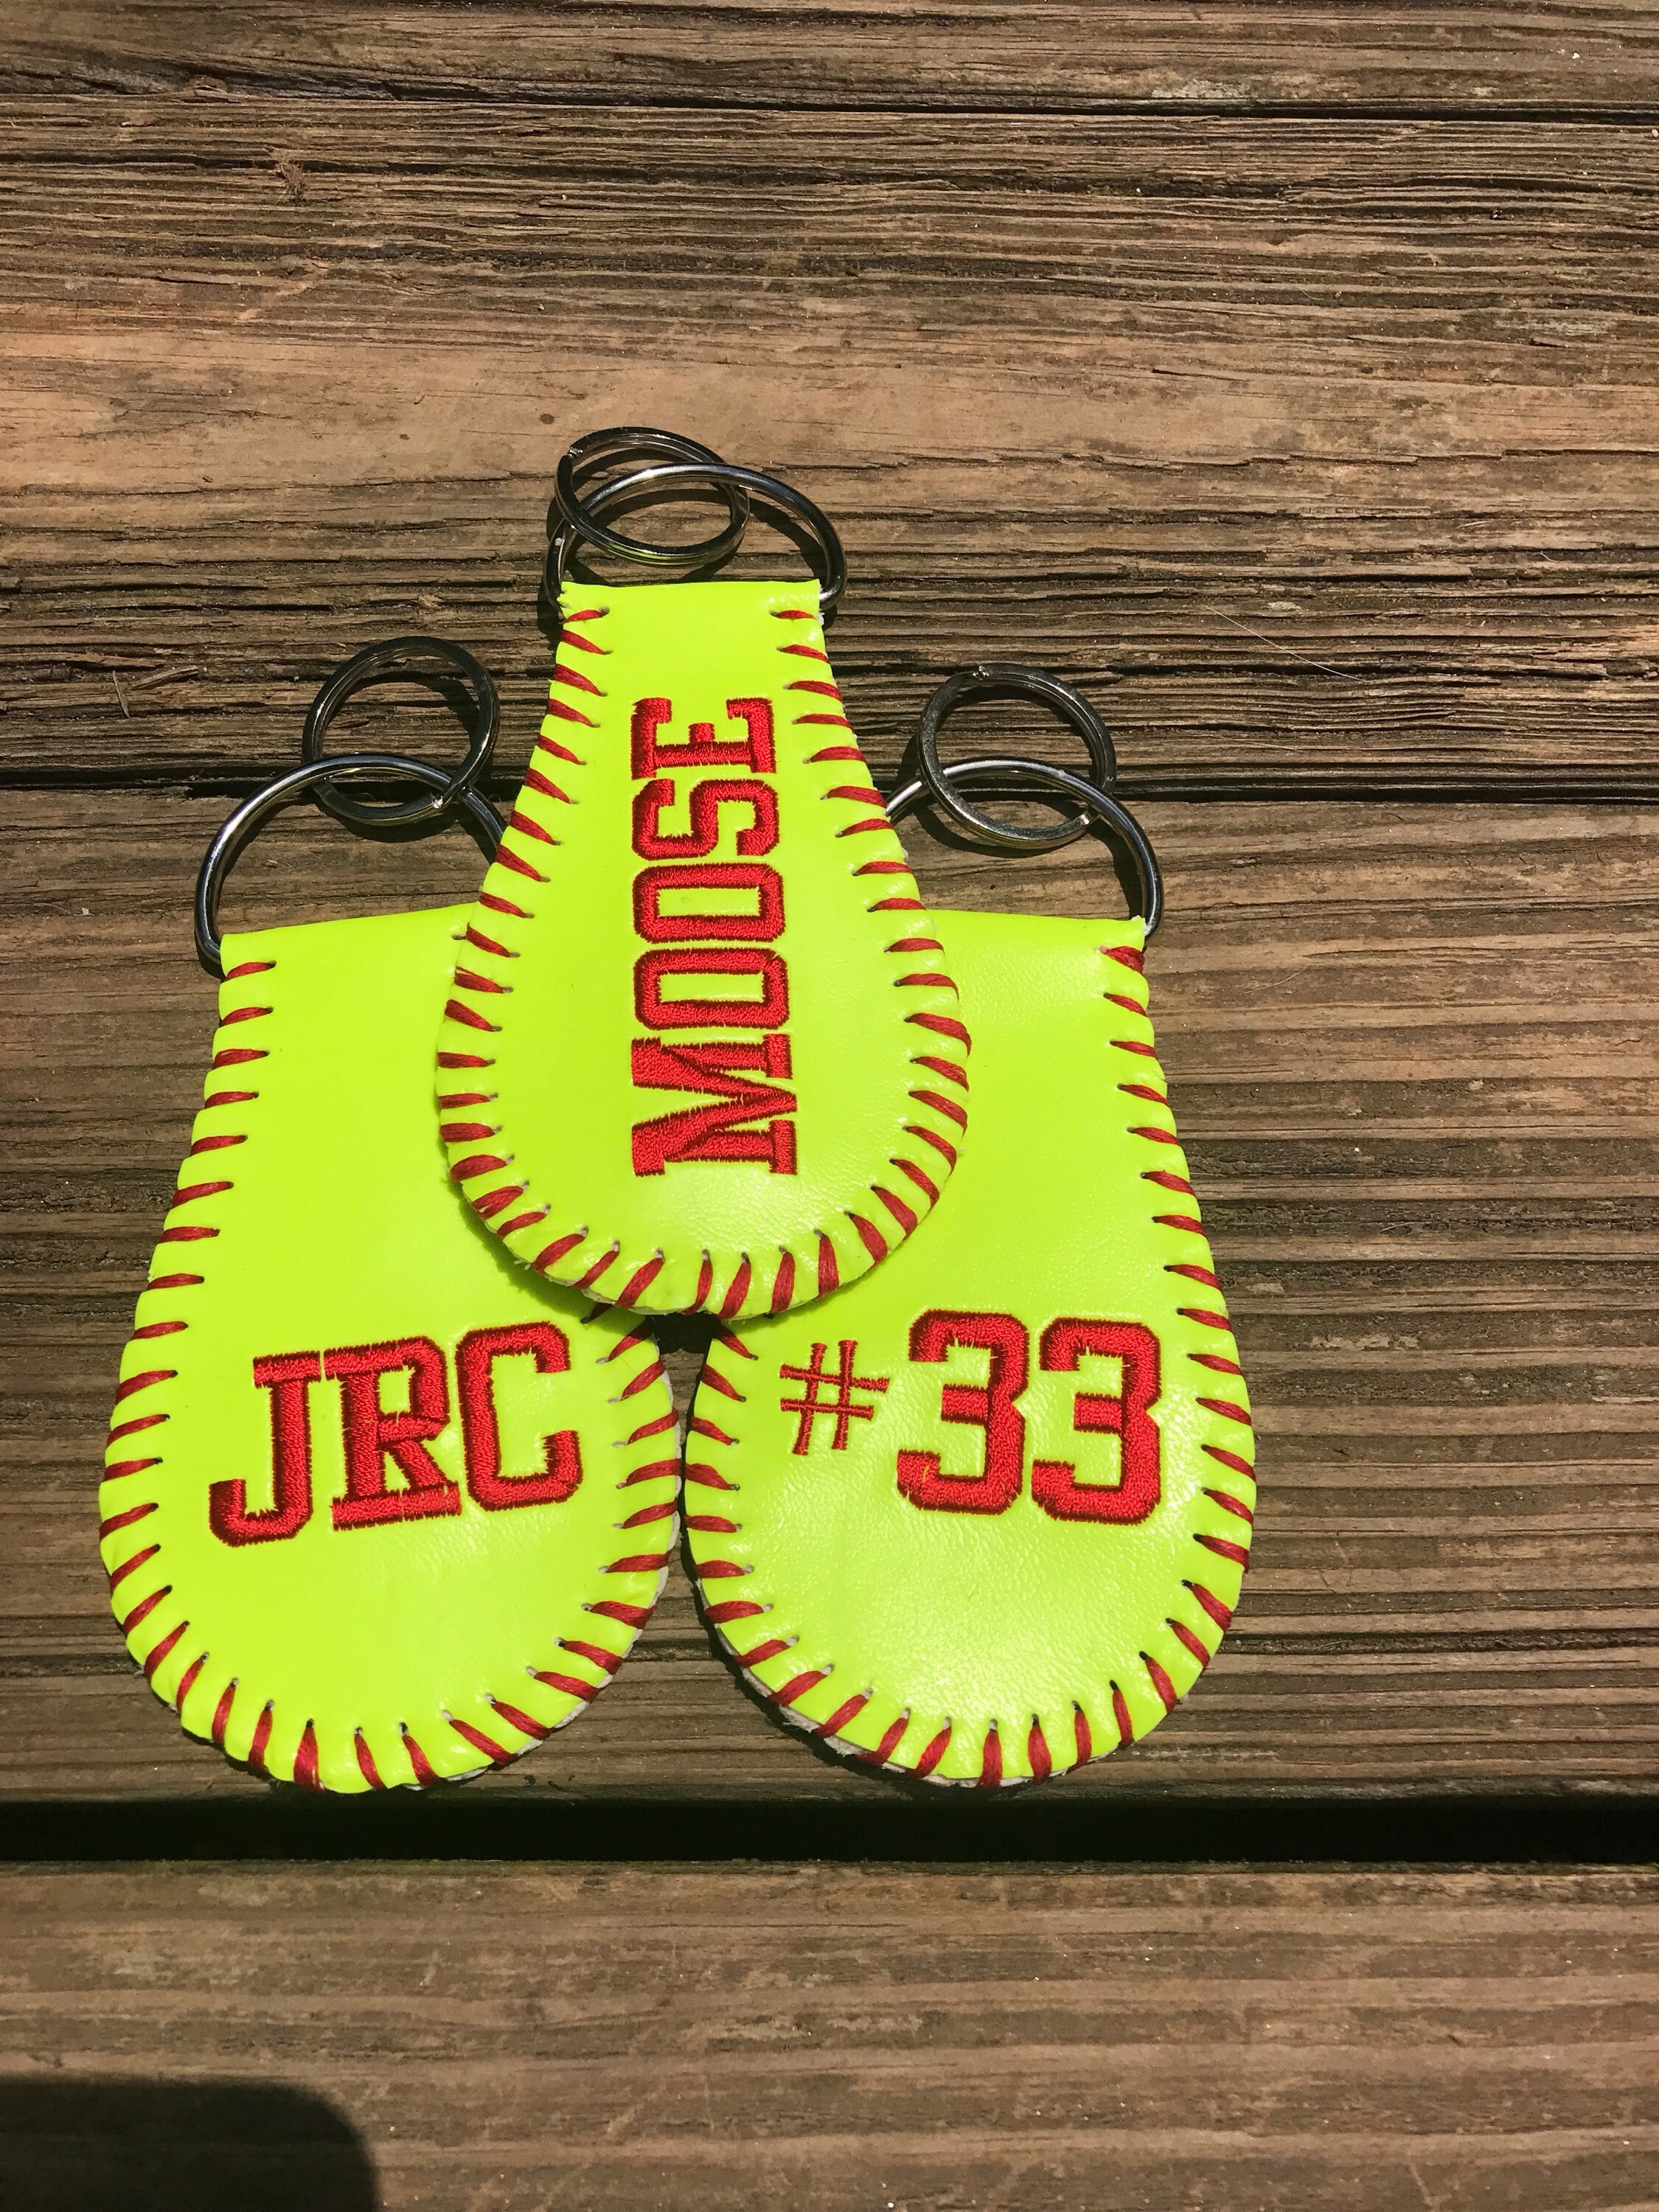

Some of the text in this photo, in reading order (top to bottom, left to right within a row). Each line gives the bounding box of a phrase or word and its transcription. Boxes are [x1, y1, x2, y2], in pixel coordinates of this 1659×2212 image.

[631, 697, 797, 1176] MOOSE
[209, 1321, 582, 1547] JRC
[779, 1310, 1161, 1525] #33
